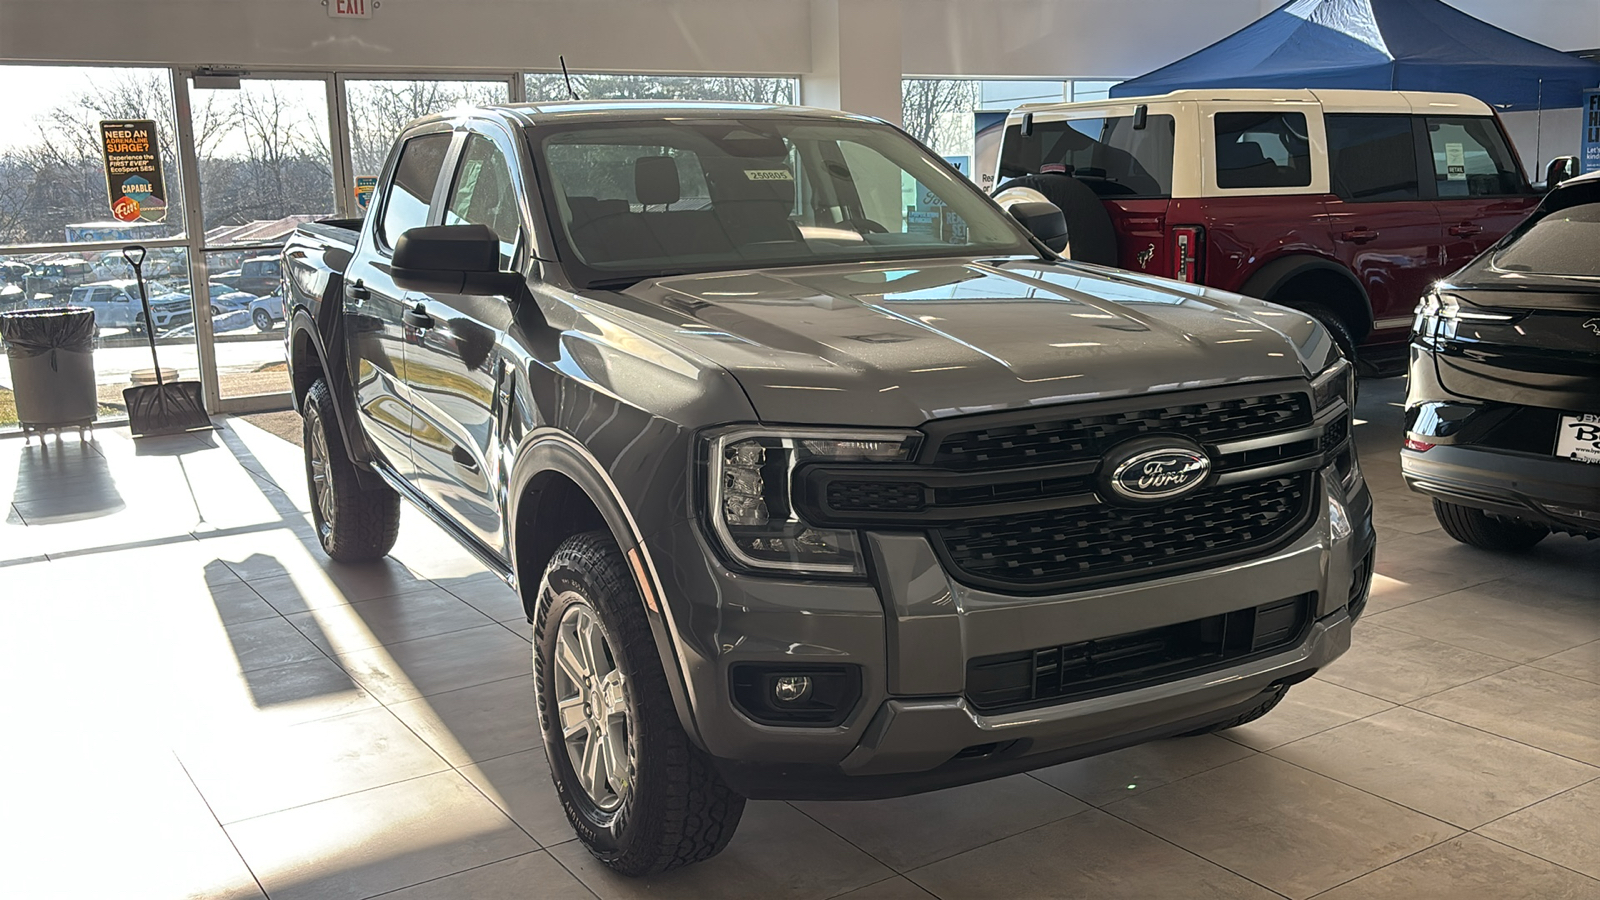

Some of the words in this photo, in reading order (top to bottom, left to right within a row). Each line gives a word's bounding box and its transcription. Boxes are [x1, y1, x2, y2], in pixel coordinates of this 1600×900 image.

[105, 130, 132, 138] NEED
[133, 130, 148, 138] AN
[107, 143, 149, 153] SURGE?
[750, 172, 787, 180] 250805
[982, 174, 995, 182] Rea
[121, 184, 153, 193] CAPABLE
[115, 202, 138, 218] Fun
[1138, 459, 1189, 489] Ford
